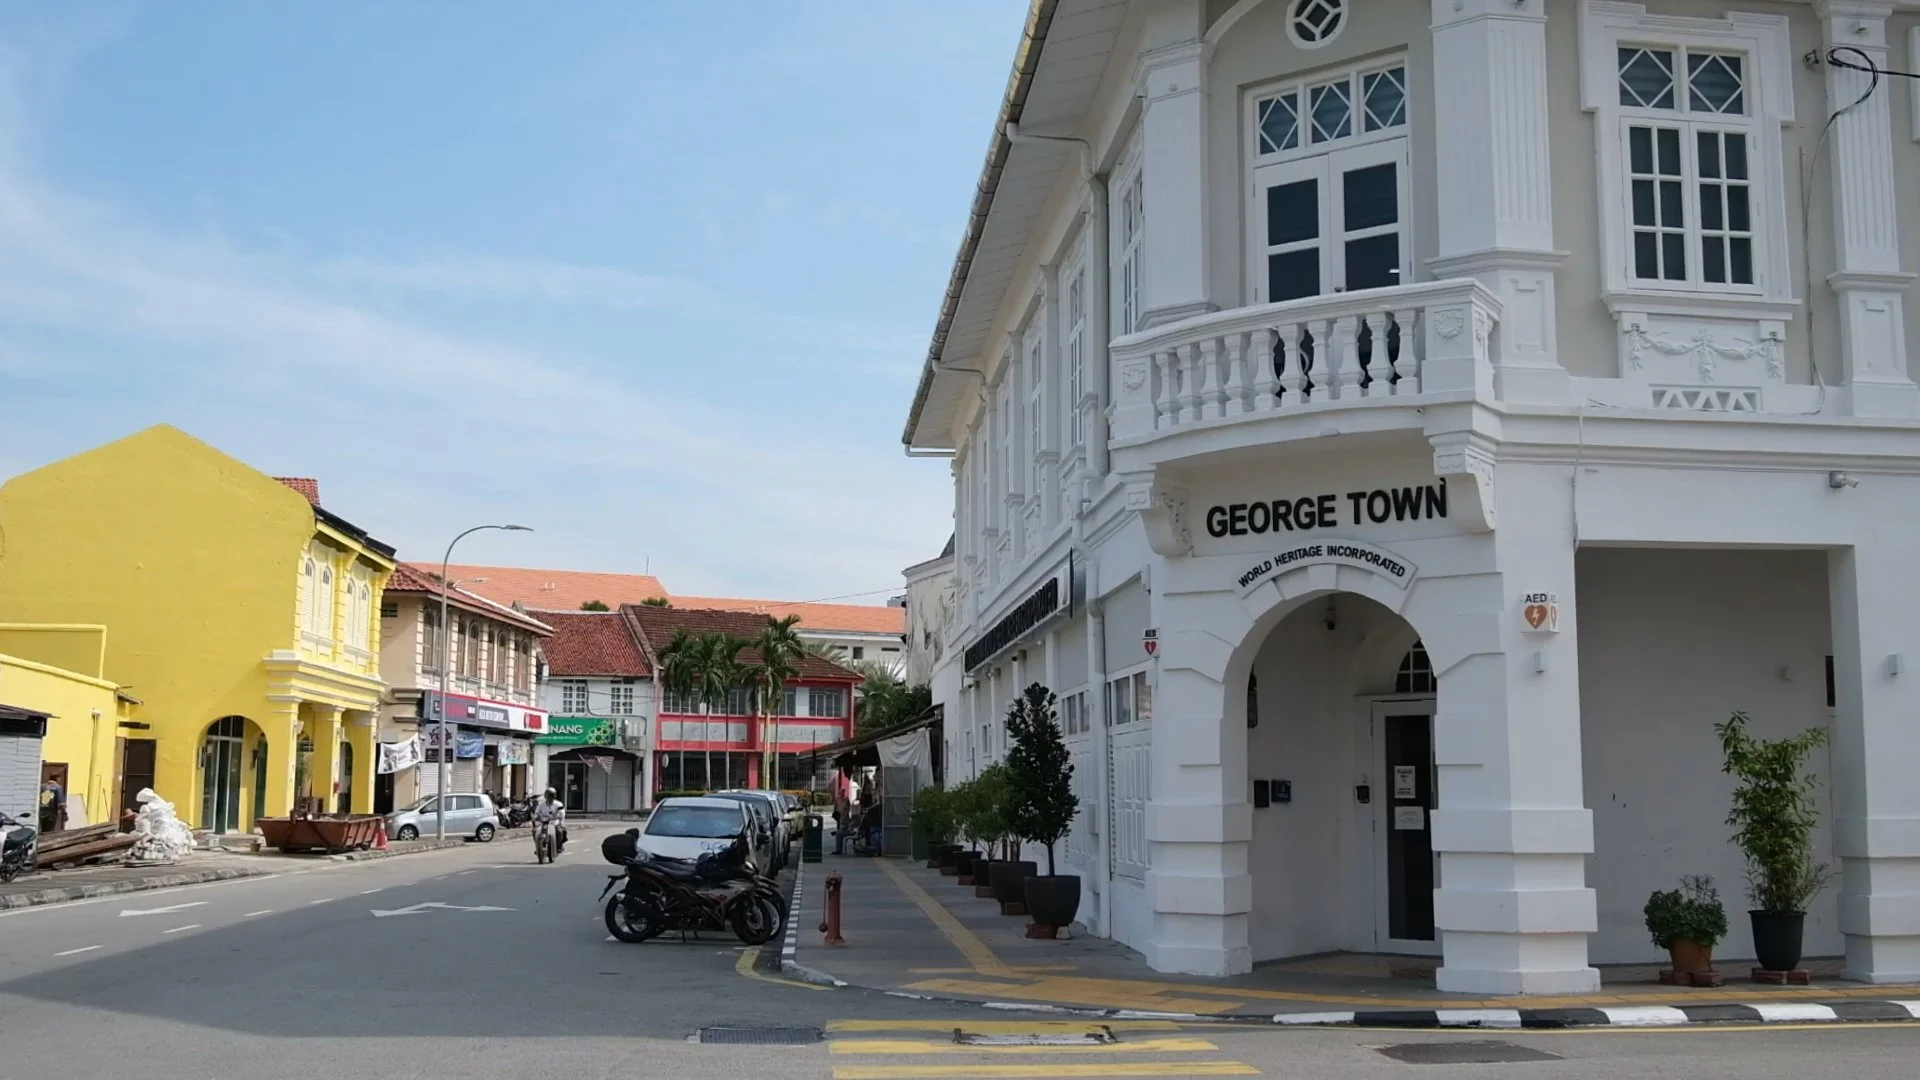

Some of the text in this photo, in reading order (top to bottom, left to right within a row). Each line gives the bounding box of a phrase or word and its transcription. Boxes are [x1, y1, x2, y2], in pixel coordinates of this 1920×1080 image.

[1206, 484, 1447, 538] GEORGE TOWN
[1238, 545, 1406, 588] WORLD HERITAGE INCORPORATED
[1525, 593, 1548, 603] AED
